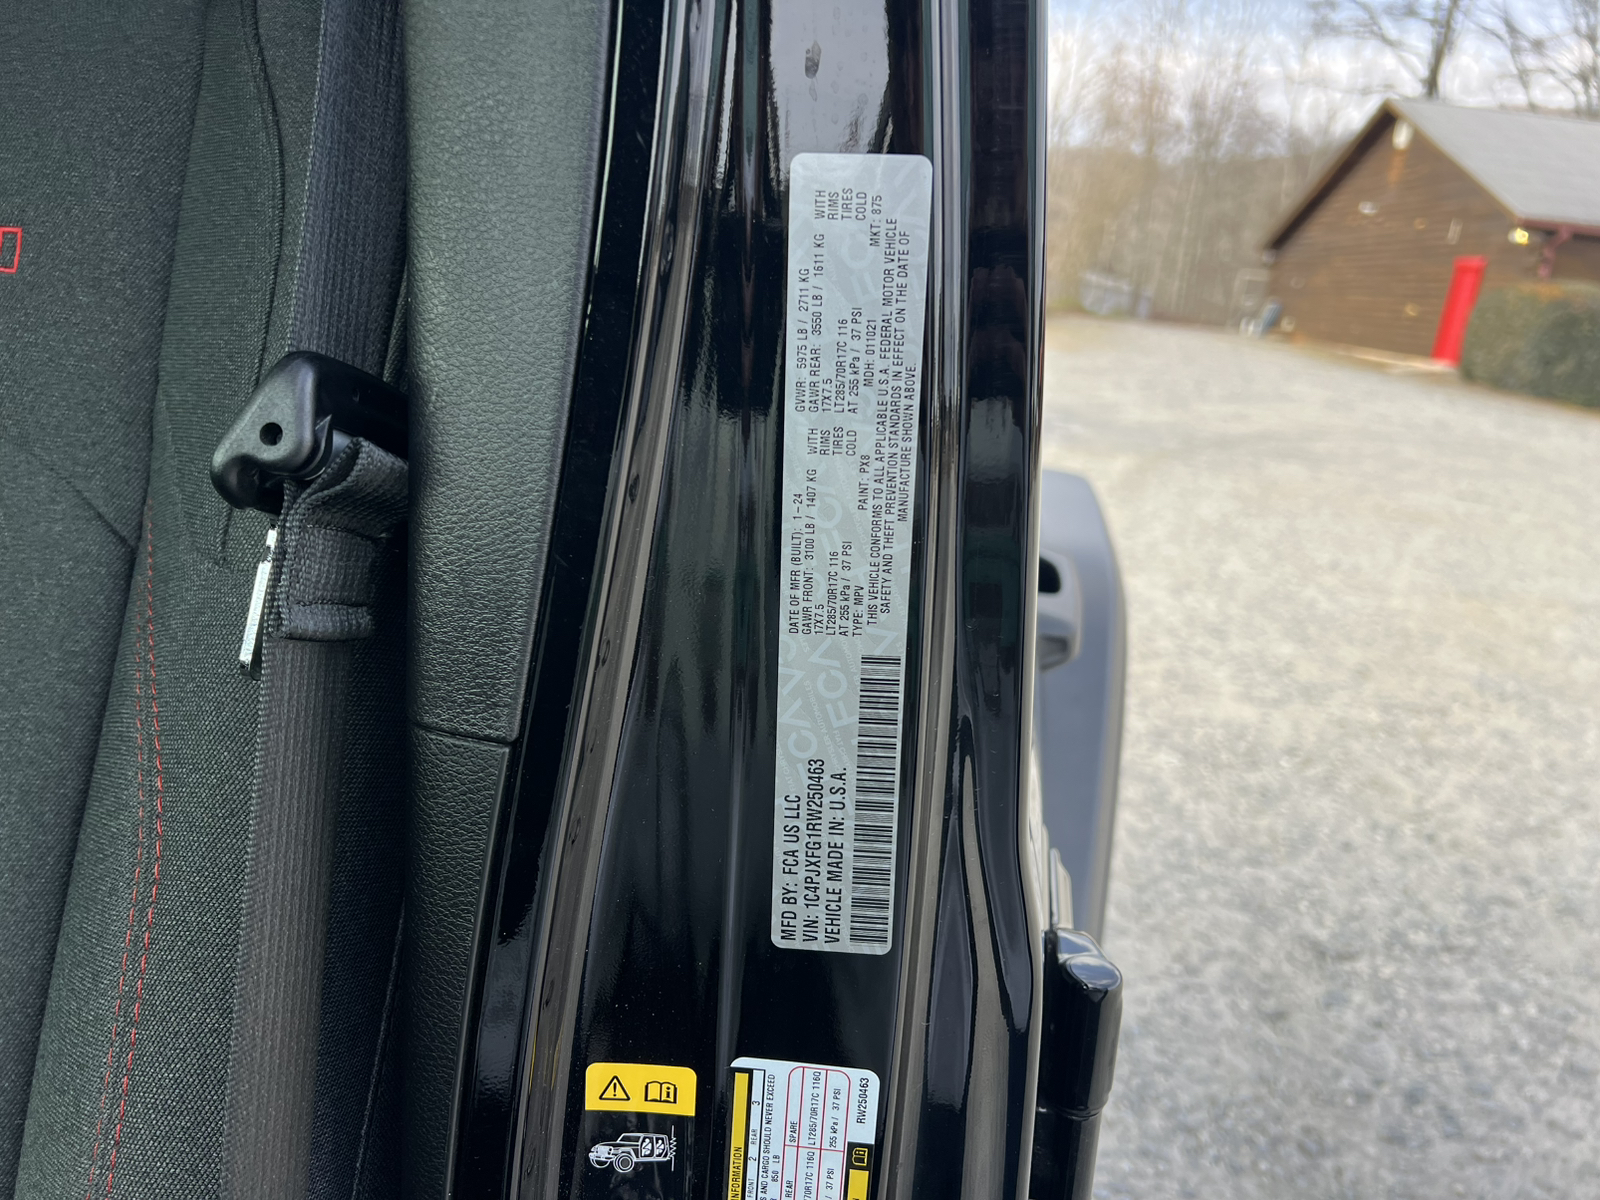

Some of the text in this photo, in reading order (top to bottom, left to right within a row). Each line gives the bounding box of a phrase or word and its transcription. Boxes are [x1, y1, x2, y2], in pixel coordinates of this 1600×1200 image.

[814, 190, 826, 219] WITH
[828, 192, 839, 220] RIMS
[841, 188, 853, 220] TIRES
[855, 192, 867, 221] COLD
[870, 195, 882, 247] MKT: 875
[814, 234, 824, 248] KG
[799, 268, 809, 282] KG
[814, 254, 823, 277] 1611
[798, 288, 808, 312] 2711
[813, 295, 822, 306] LB
[812, 312, 822, 335] 3550
[852, 308, 862, 324] PSI
[797, 329, 807, 340] LB
[852, 329, 861, 341] 37
[797, 345, 807, 369] 5975
[810, 344, 821, 376] REAR:
[864, 319, 876, 387] MDH: 011021
[835, 319, 847, 413] LT285/70R17C 116
[850, 357, 860, 375] kPa
[795, 377, 806, 412] GVWR:
[809, 381, 819, 412] GAWR
[822, 378, 832, 412] 17X7.5
[849, 379, 859, 397] 255
[848, 401, 858, 414] AT
[867, 219, 897, 625] THIS VEHICLE CONFORMS TO ALL APPLICABLE U.S.A. FEDERAL MOTOR VEHICLE
[880, 231, 910, 614] SAFETY AND THEFT PREVENTION STANDARDS IN EFFECT ON THE DATE OF
[807, 428, 818, 454] WITH
[820, 430, 830, 455] RIMS
[833, 426, 843, 456] TIRES
[846, 430, 856, 456] COLD
[898, 363, 916, 522] MANUFACTURE SHOWN ABOVE.
[807, 469, 816, 482] KG
[858, 455, 870, 510] PAINT: PX8
[807, 486, 816, 507] 1407
[806, 523, 814, 534] LB
[791, 528, 802, 565] (BUILT):
[805, 538, 814, 560] 3100
[842, 541, 852, 556] PSI
[842, 560, 851, 571] 37
[790, 570, 800, 590] MFR
[803, 568, 813, 602] FRONT:
[790, 594, 800, 606] OF
[826, 552, 838, 635] LT285/70R17C 116
[840, 585, 850, 601] kPa
[789, 610, 799, 633] DATE
[802, 607, 812, 634] GAWR
[814, 604, 824, 635] 17X7.5
[840, 605, 849, 620] 255
[853, 585, 864, 637] TYPE: MPV
[839, 624, 849, 636] AT
[830, 768, 846, 810] U.S.A.
[784, 795, 800, 819] LLC
[784, 825, 799, 843] US
[829, 817, 844, 836] IN:
[783, 850, 798, 875] FCA
[803, 759, 824, 942] VIN: 1C4PJXFG1RW250463
[827, 842, 843, 882] MADE
[782, 883, 798, 905] BY:
[781, 911, 797, 940] MFD
[825, 888, 842, 943] VEHICLE
[766, 1074, 775, 1100] EXCEED
[808, 1071, 821, 1145] LT285/70R17C 116Q
[832, 1102, 839, 1110] 37
[857, 1078, 869, 1124] RW250463
[765, 1103, 773, 1125] NEVER
[750, 1129, 758, 1145] REAR
[763, 1127, 771, 1154] SHOULD
[789, 1121, 797, 1143] SPARE
[771, 1155, 780, 1182] 850 LB
[804, 1152, 815, 1200] 70R17C 116Q
[827, 1182, 833, 1190] 37
